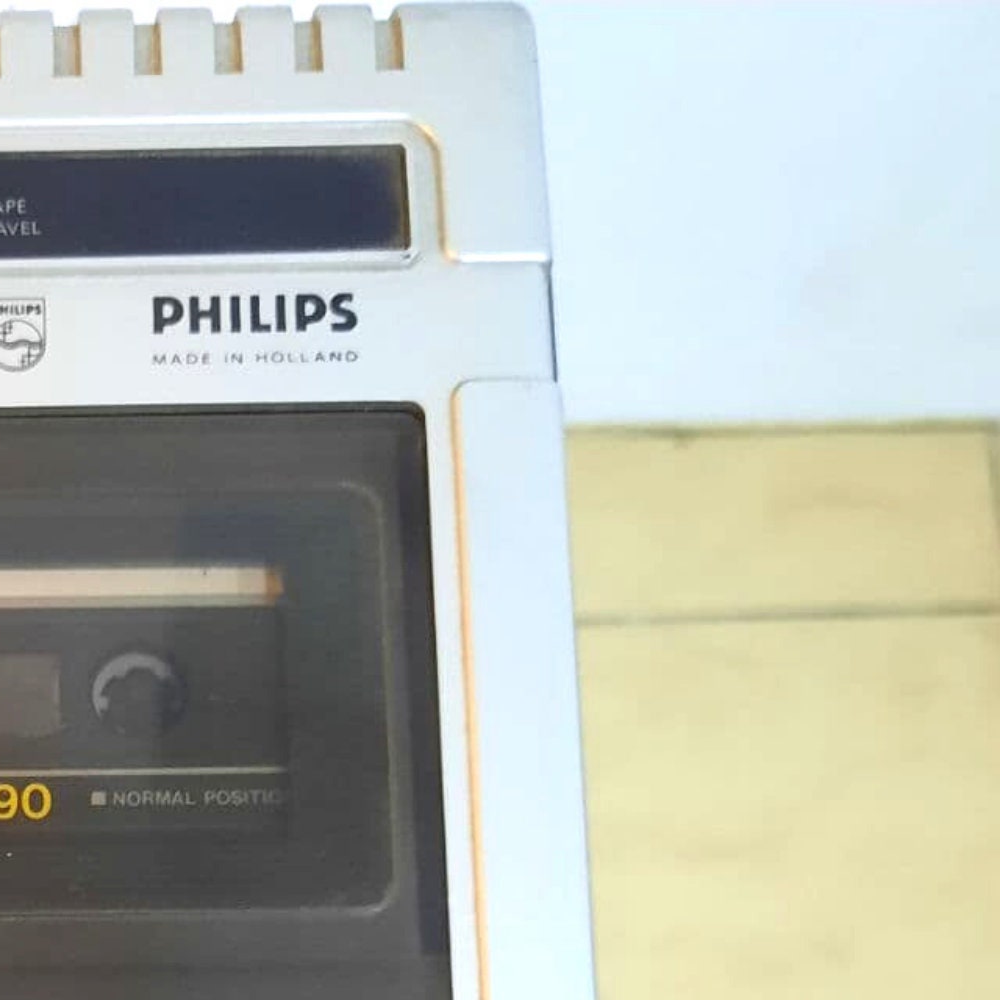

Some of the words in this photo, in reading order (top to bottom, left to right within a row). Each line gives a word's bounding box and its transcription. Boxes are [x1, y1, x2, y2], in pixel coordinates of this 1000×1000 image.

[152, 293, 358, 334] PHILIPS
[152, 351, 210, 365] MADE
[224, 351, 244, 364] IN
[255, 350, 359, 364] HOLLAND
[112, 790, 197, 807] NORMAL
